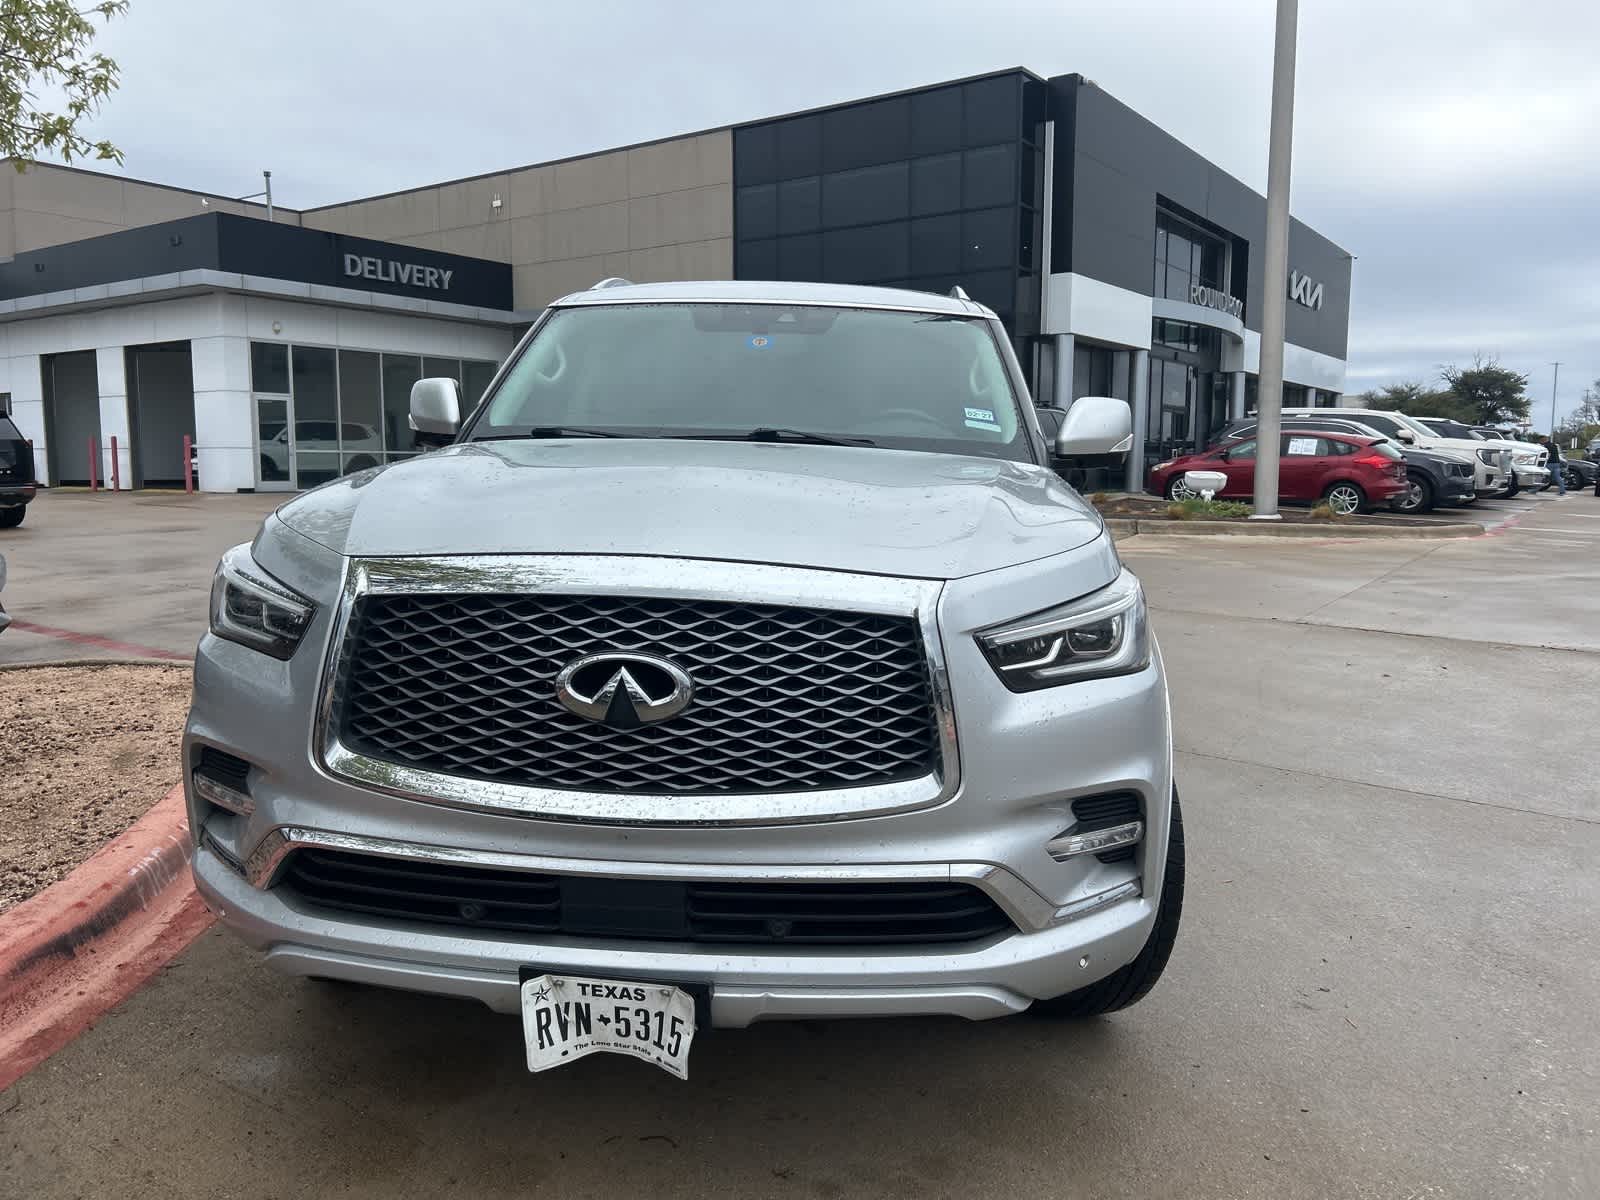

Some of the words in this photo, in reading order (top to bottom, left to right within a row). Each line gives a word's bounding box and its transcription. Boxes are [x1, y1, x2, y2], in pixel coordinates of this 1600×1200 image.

[344, 253, 453, 290] DELIVERY
[577, 982, 646, 1001] TEXAS
[535, 1001, 592, 1050] RVN
[614, 1006, 685, 1058] 5315
[574, 1042, 589, 1051] The
[632, 1045, 652, 1056] State
